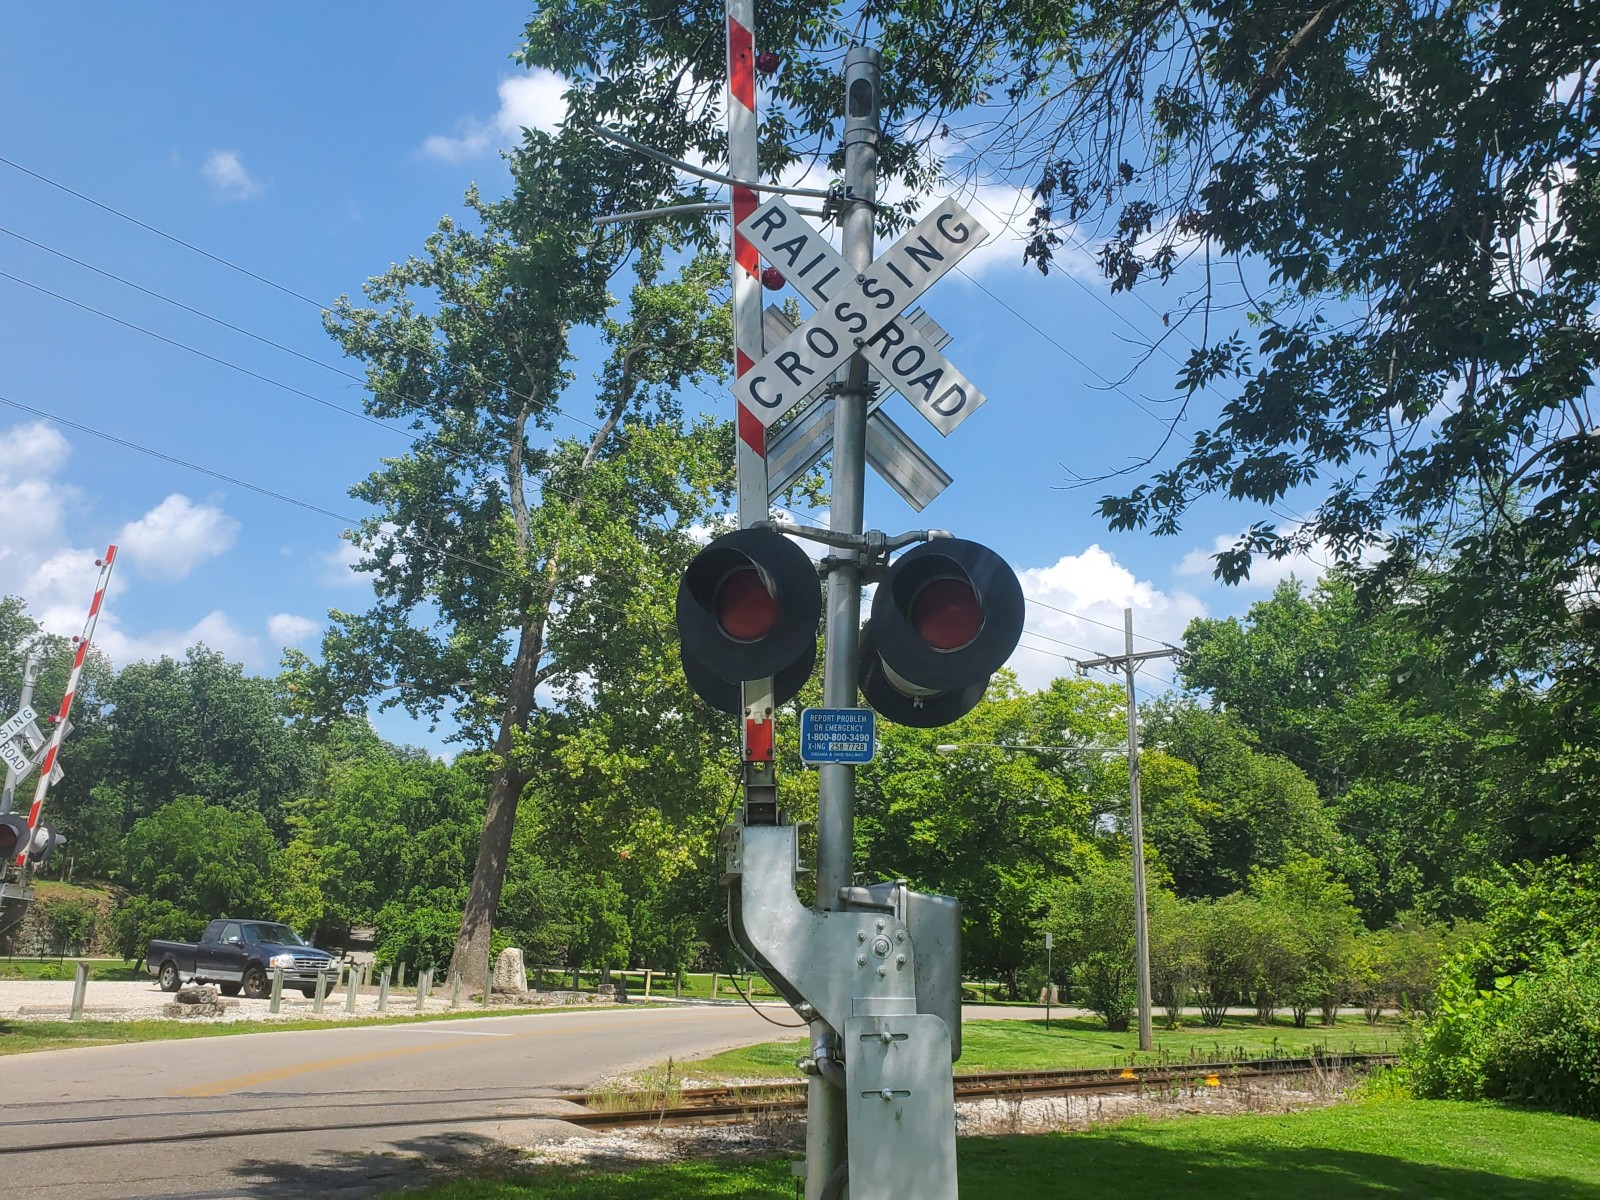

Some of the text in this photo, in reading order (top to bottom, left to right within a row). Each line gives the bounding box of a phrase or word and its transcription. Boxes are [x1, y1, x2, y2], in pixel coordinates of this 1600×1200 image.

[749, 213, 970, 409] CROSSING
[750, 205, 967, 417] RAIL ROAD
[806, 734, 870, 742] 1-800-800-3490
[814, 723, 823, 731] OR
[0, 742, 25, 770] ROAD
